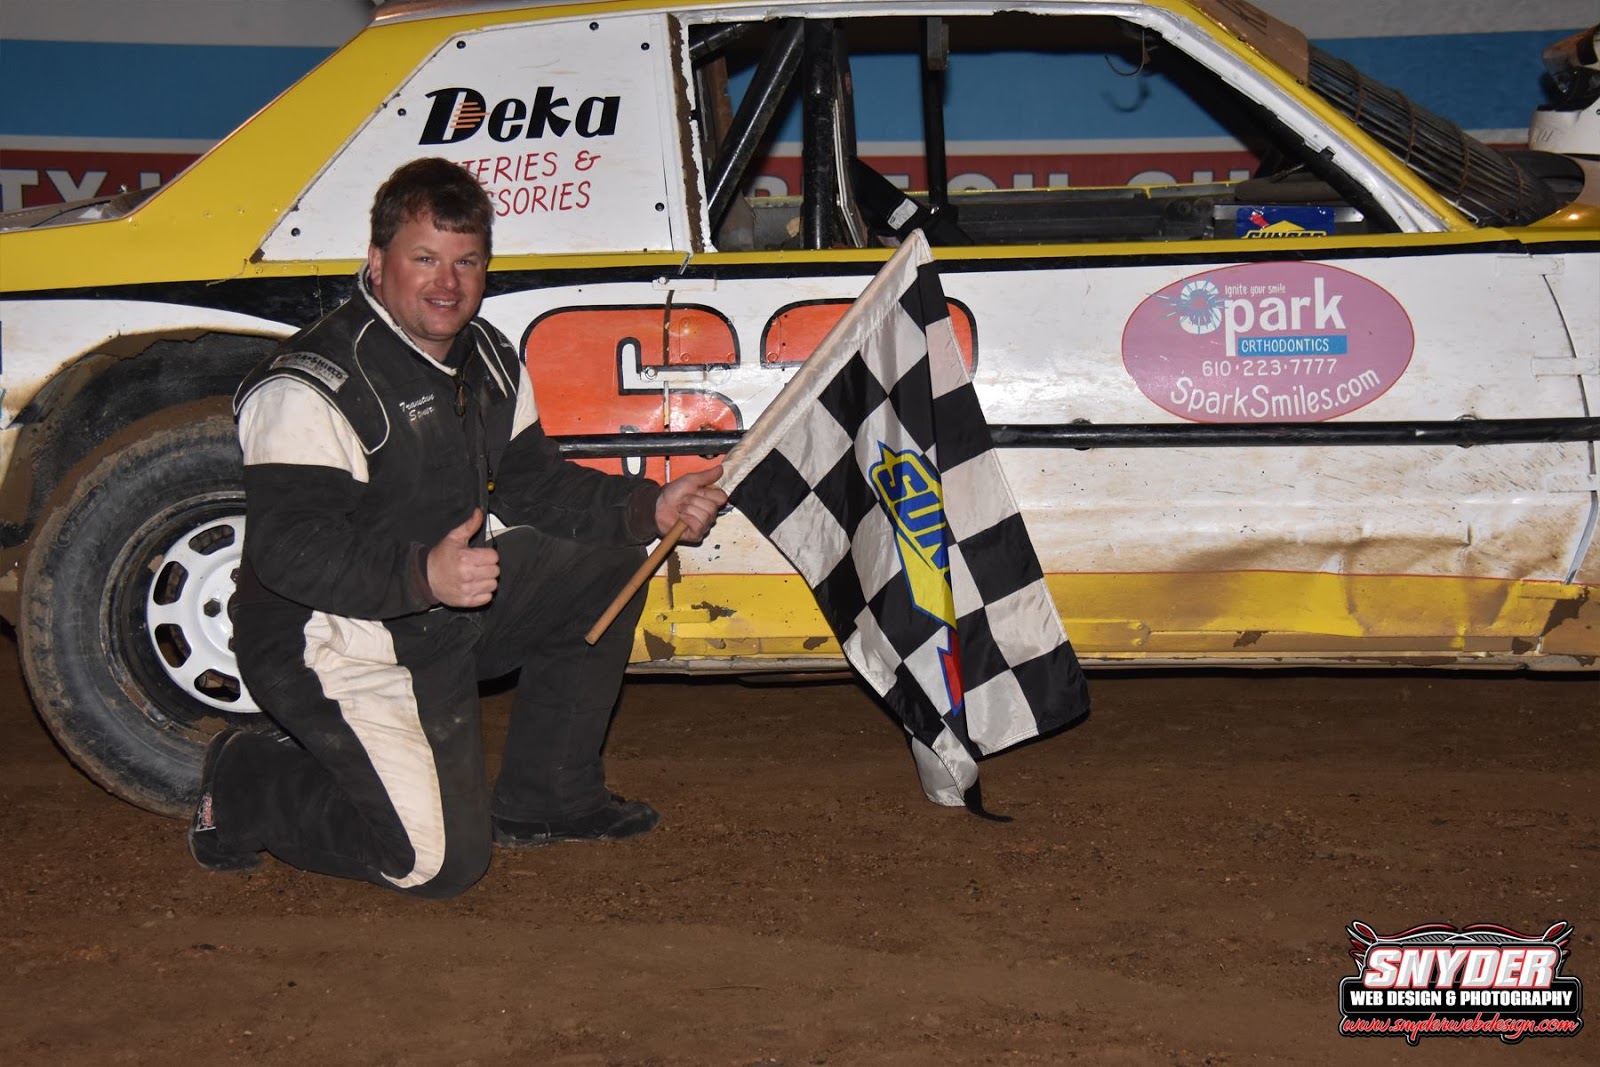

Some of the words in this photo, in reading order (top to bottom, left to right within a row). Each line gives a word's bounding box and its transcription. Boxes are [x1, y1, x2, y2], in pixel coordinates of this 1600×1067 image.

[418, 86, 621, 145] Deka
[449, 151, 559, 185] TERIES
[575, 150, 601, 171] &
[487, 181, 591, 217] SORIES
[1250, 285, 1266, 297] your
[1268, 283, 1286, 294] smile
[1241, 338, 1330, 353] ORTHODONTICS
[1170, 369, 1381, 418] SparkSmiles.com
